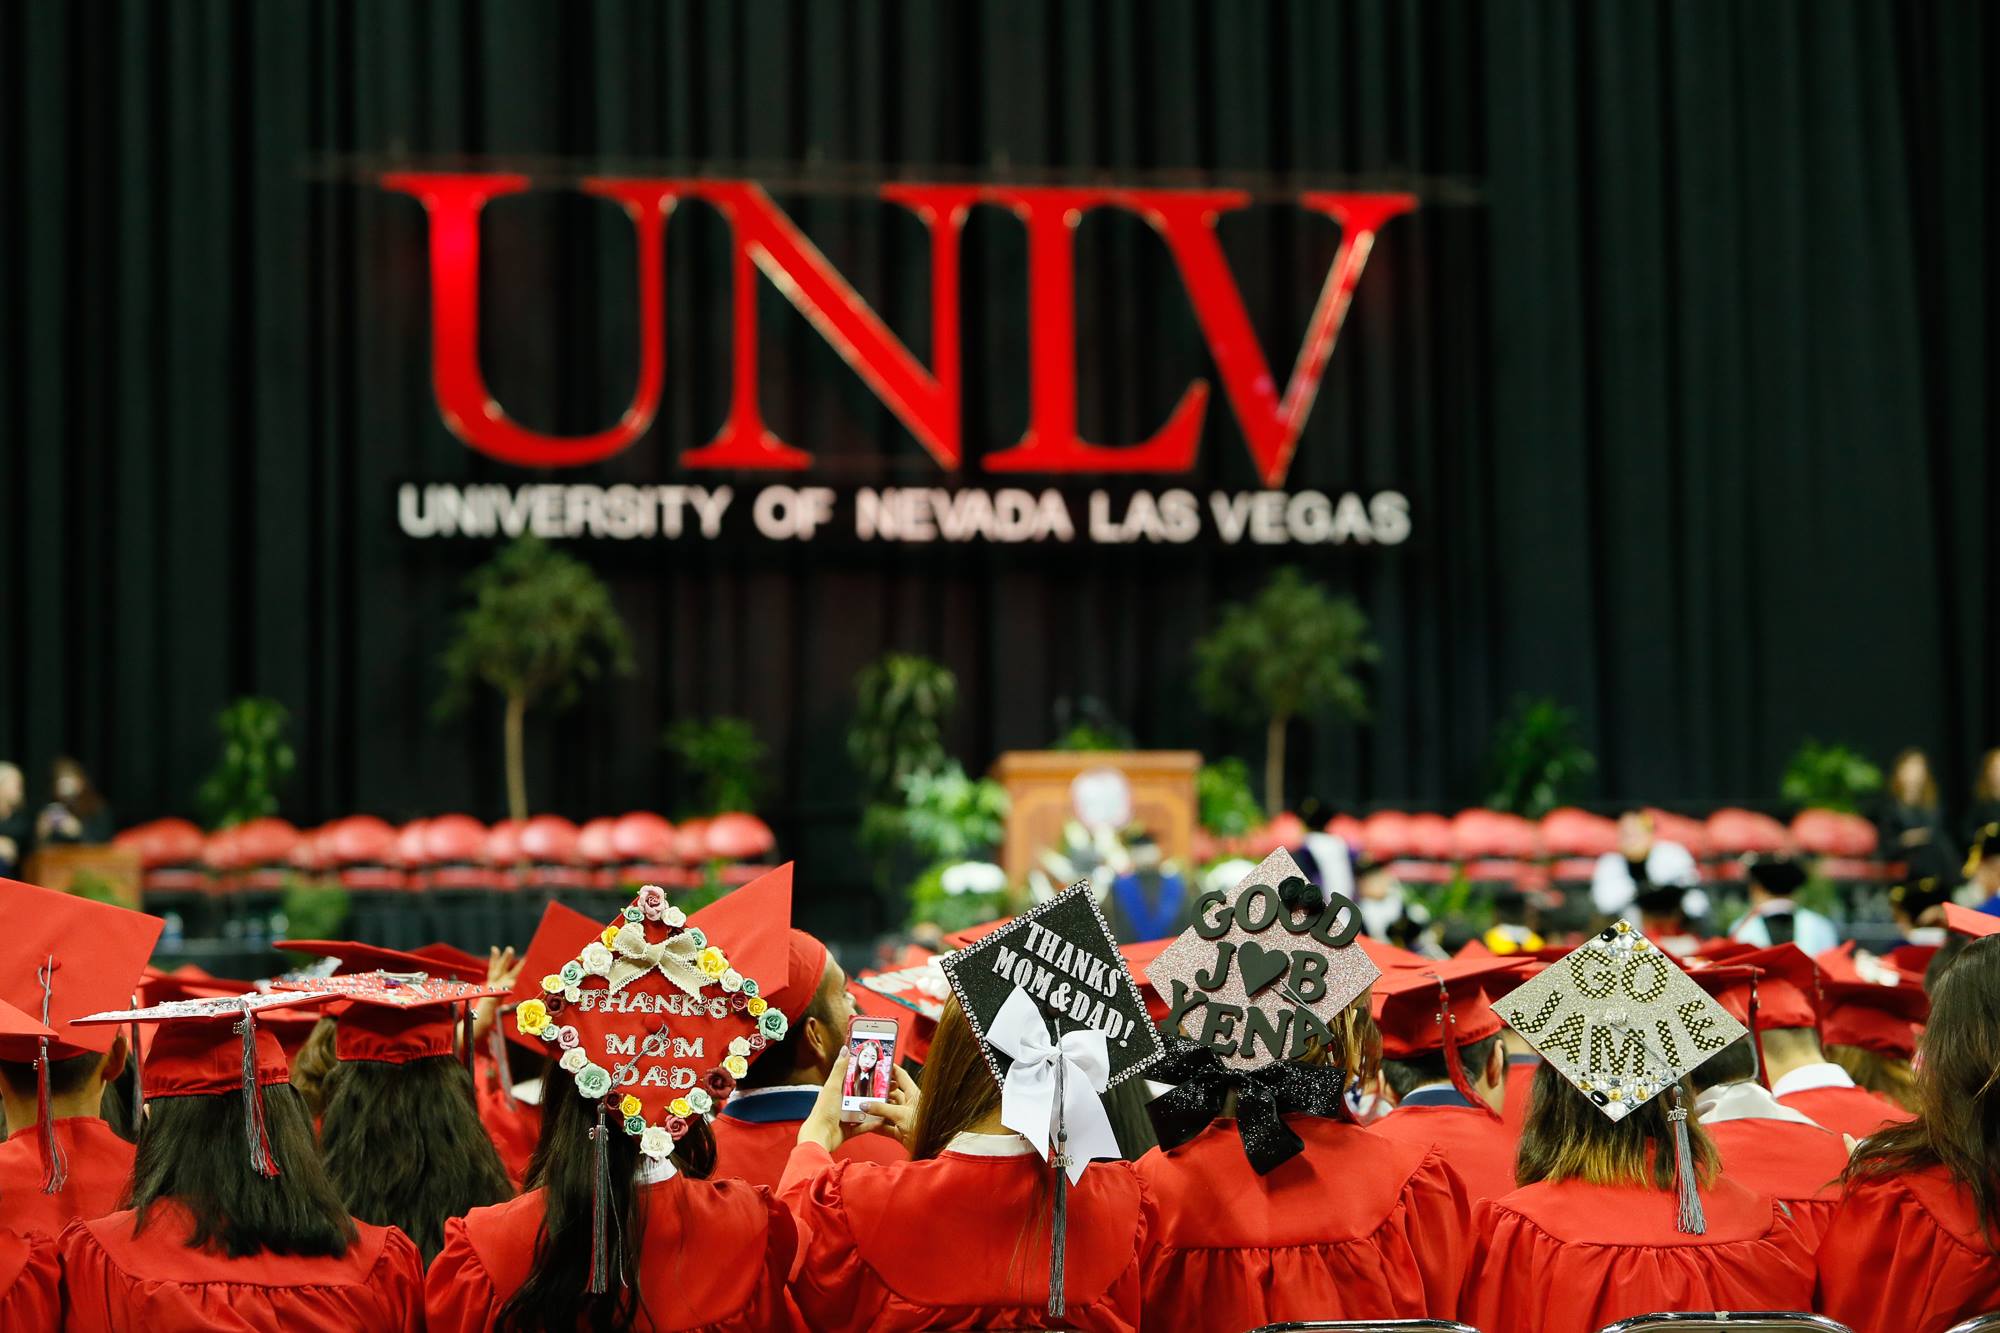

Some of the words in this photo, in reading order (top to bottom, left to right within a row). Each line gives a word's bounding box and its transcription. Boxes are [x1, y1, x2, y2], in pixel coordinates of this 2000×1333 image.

[381, 171, 1418, 487] UNLV
[399, 483, 733, 538] UNIVERSITY
[753, 485, 834, 540] OF
[855, 487, 1075, 543] NEVADA
[1089, 489, 1201, 544] LAS
[1211, 490, 1411, 545] VEGAS
[1023, 920, 1122, 998] THANKS
[1570, 949, 1668, 1003] GO
[605, 1033, 704, 1058] MOM
[1510, 990, 1726, 1077] JAMIE
[611, 1063, 697, 1089] DAD
